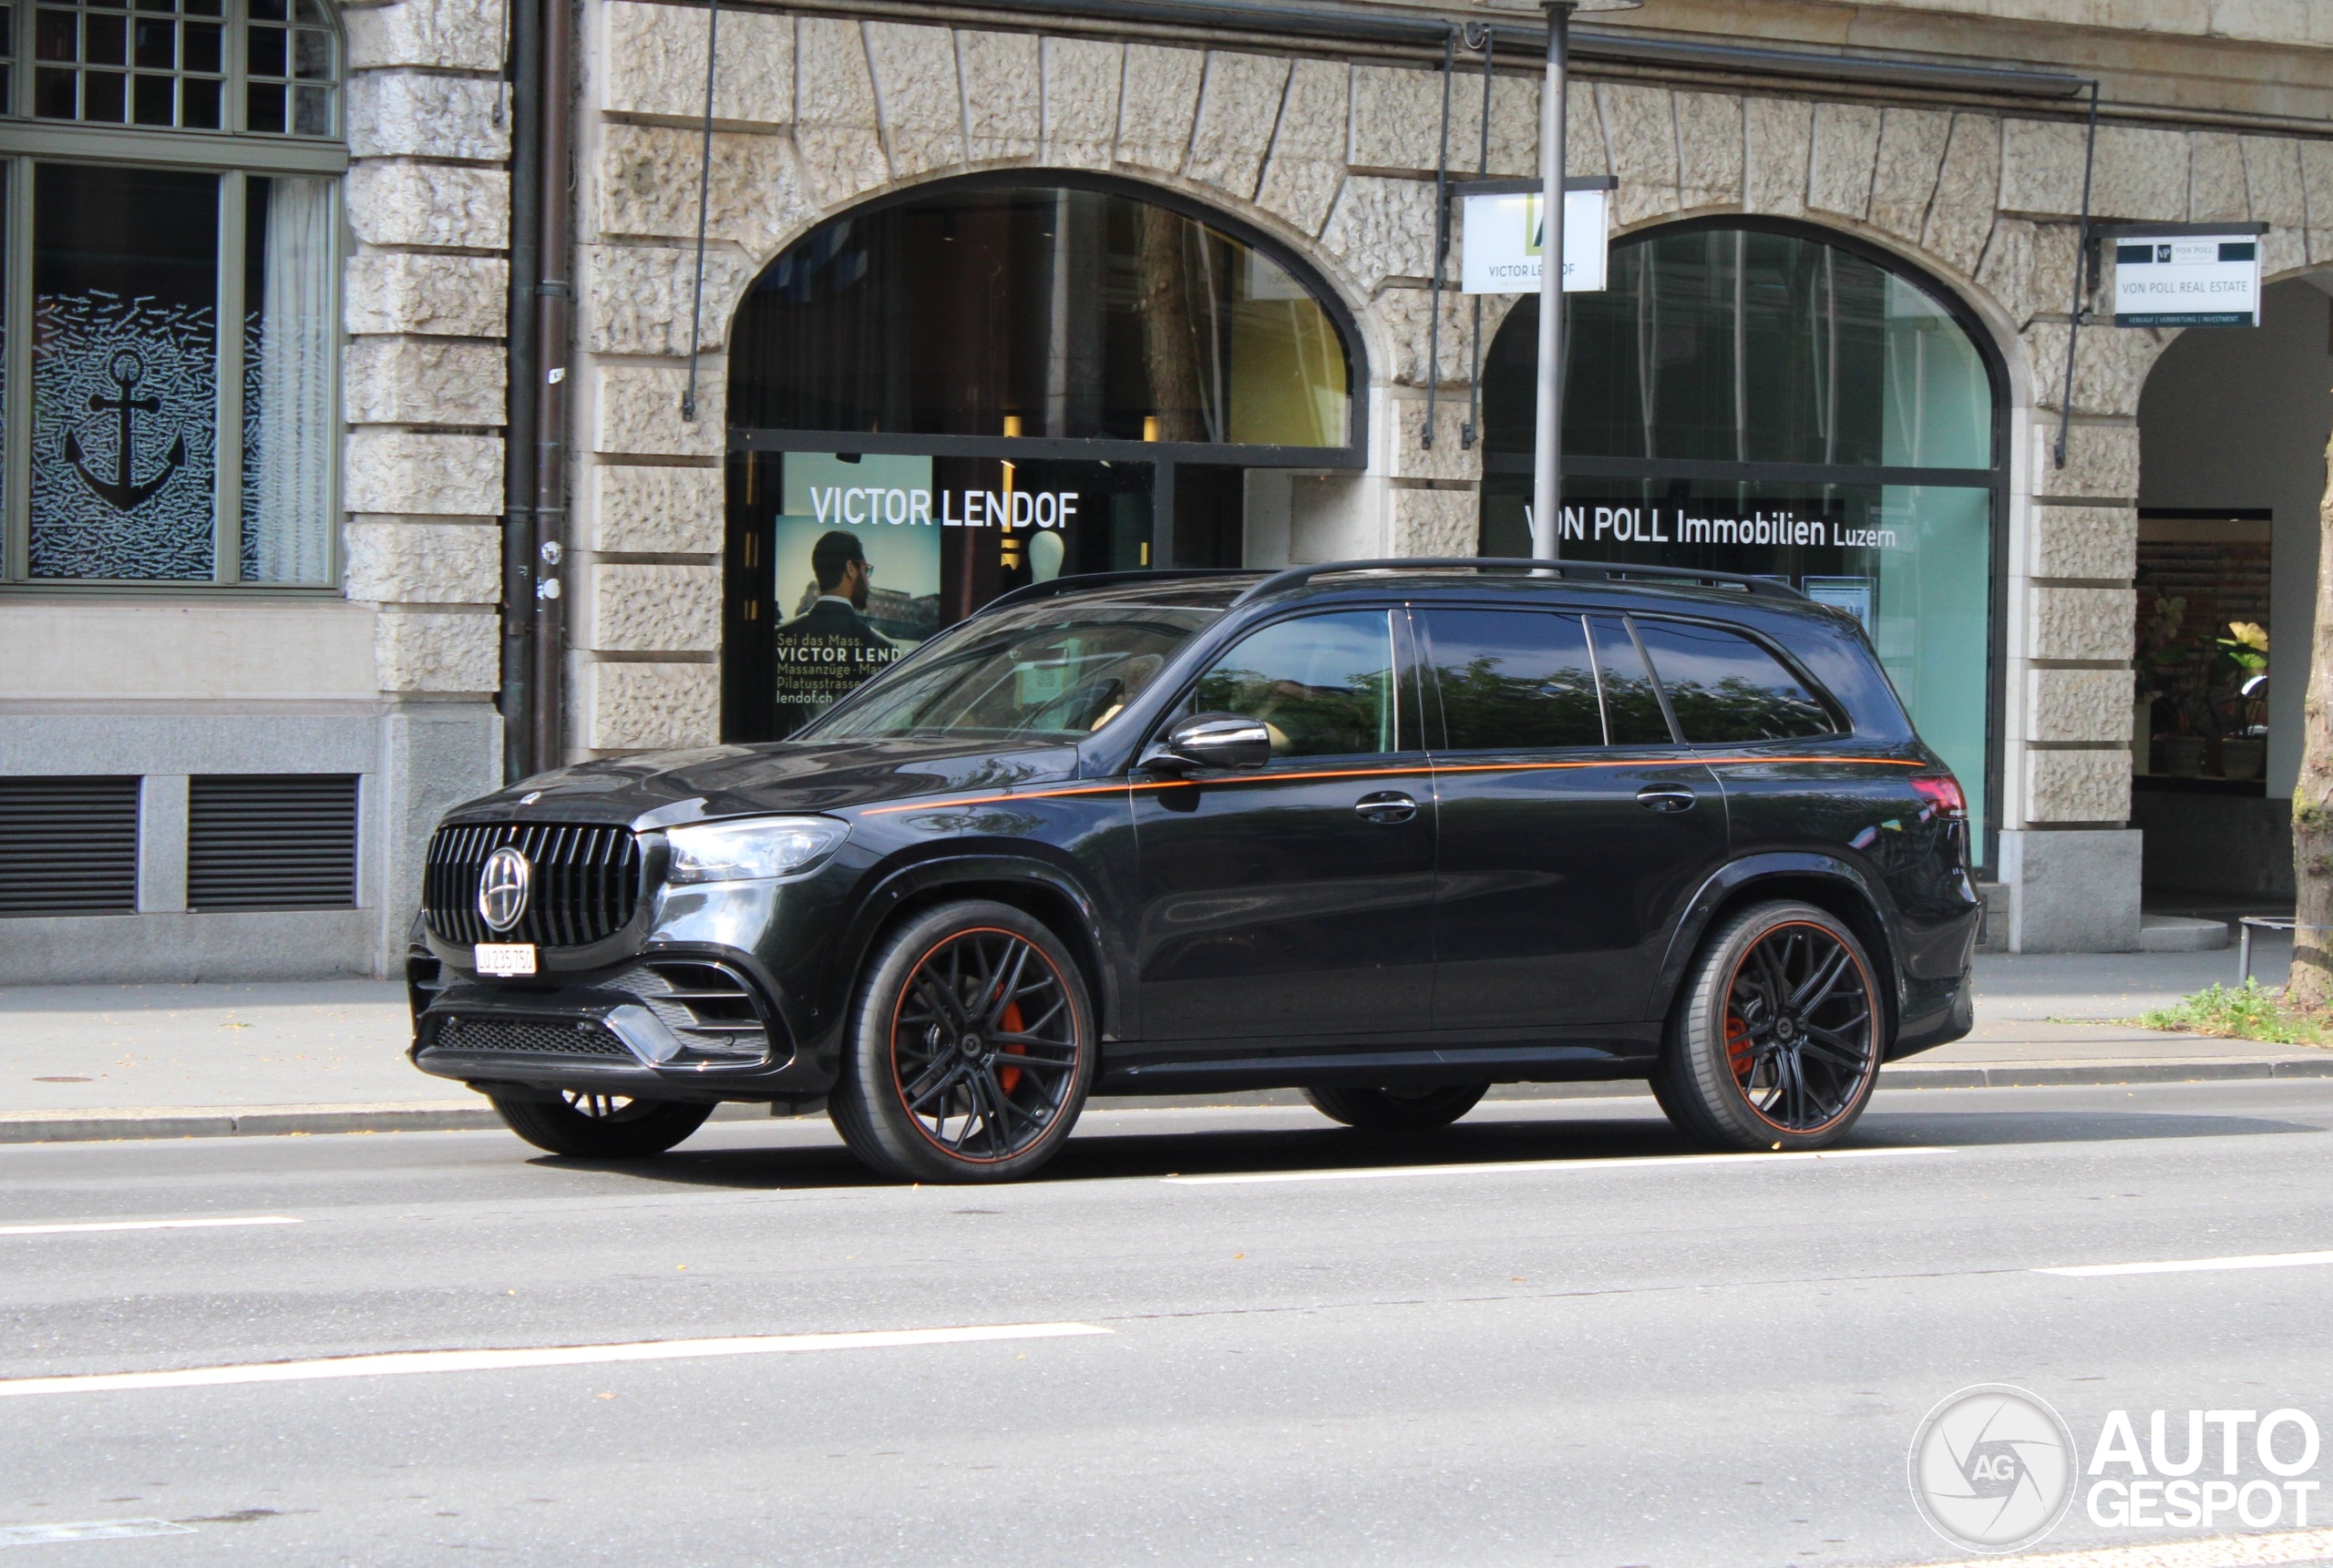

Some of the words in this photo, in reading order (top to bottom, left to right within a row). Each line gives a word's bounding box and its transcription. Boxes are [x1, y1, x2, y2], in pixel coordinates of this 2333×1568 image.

[2194, 246, 2213, 254] POLL
[1488, 265, 1528, 277] VICTOR
[1531, 263, 1575, 276] LEOF
[2122, 282, 2145, 294] VON
[2149, 282, 2175, 293] POLL
[2180, 282, 2205, 292] REAL
[2210, 281, 2247, 292] ESTATE
[810, 487, 931, 526] VICTOR
[942, 489, 1079, 528] LENDOF
[1524, 506, 1585, 540] VN
[1595, 507, 1669, 542] POLL
[1678, 509, 1824, 545] Immobilien
[1833, 522, 1896, 547] Luzern
[777, 633, 797, 646] Sei
[802, 633, 823, 646] das
[828, 635, 863, 646] Mass.
[777, 648, 848, 661] VICTOR
[777, 663, 850, 678] Massanzüge
[776, 677, 861, 690] Pilatusstrasse
[776, 690, 833, 703] lendof.ch
